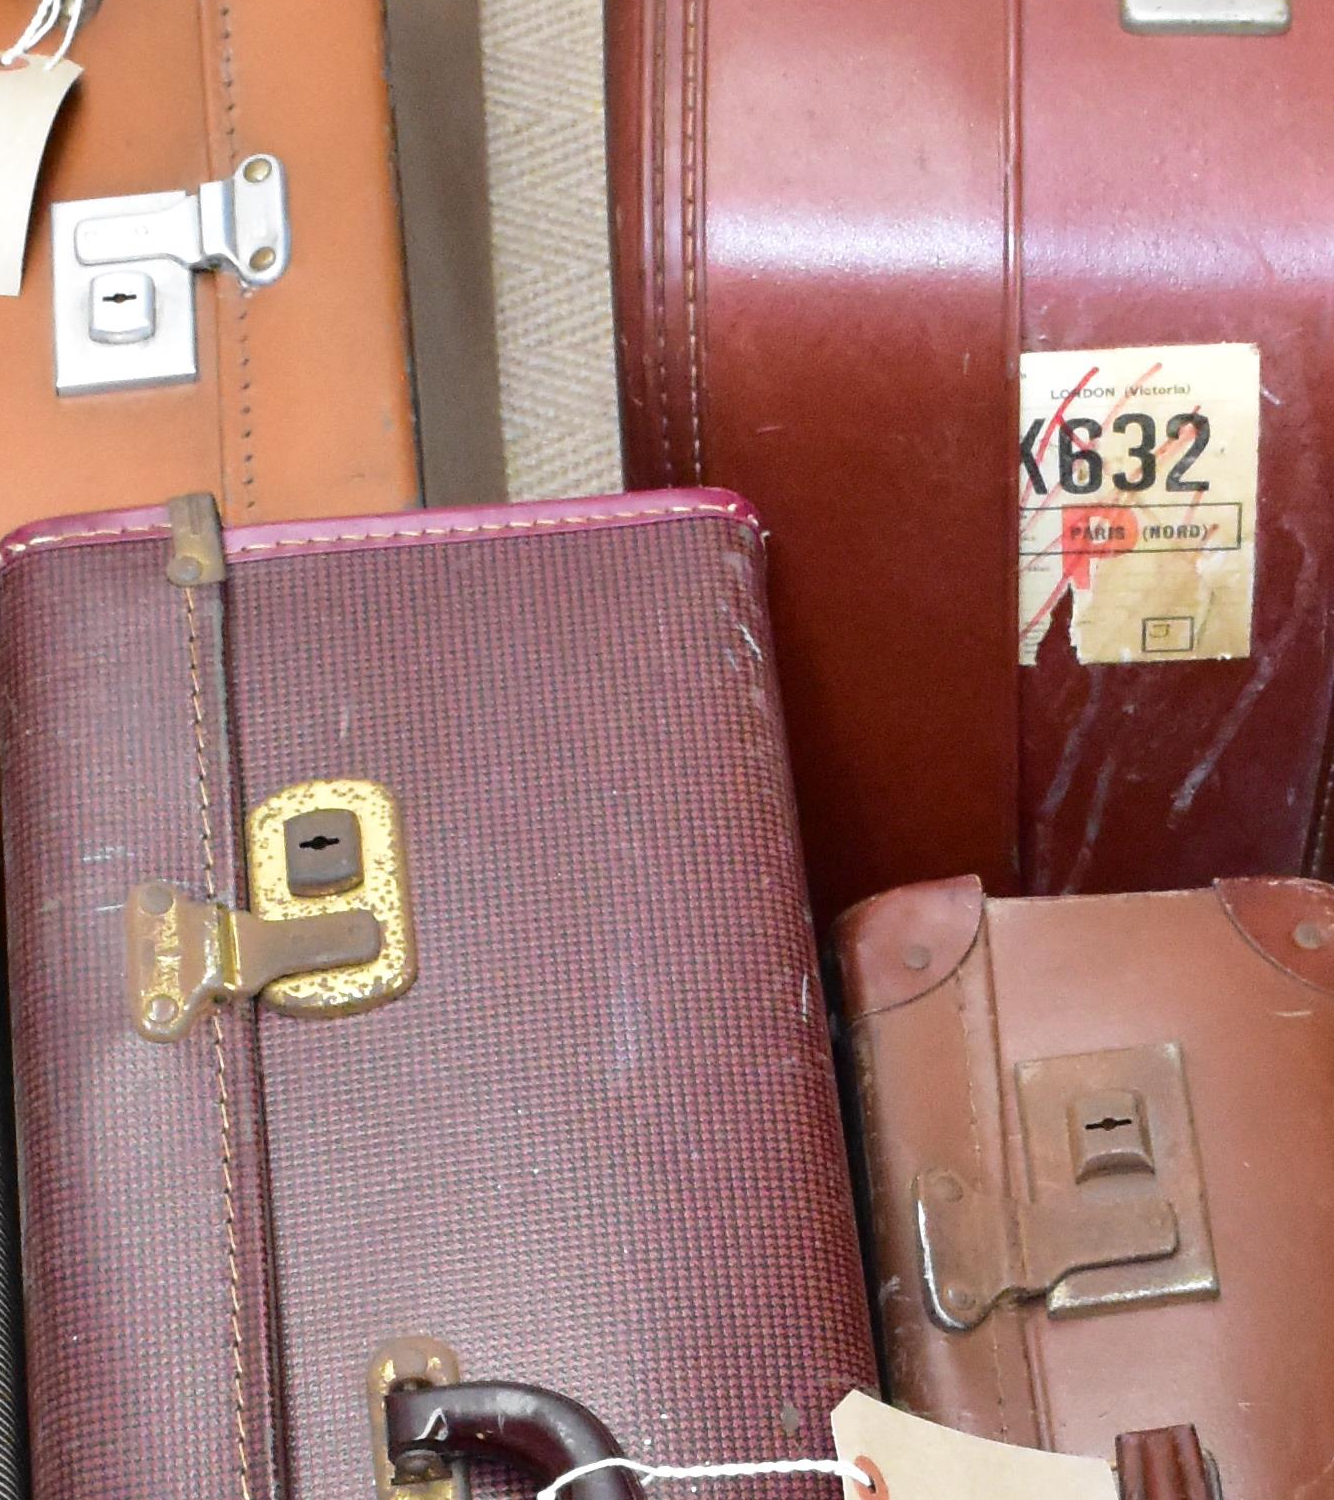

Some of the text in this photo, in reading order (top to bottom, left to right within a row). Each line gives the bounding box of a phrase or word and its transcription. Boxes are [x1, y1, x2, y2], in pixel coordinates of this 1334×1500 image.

[1050, 383, 1192, 400] LONDON (Victoria)
[1070, 523, 1209, 542] PARIS (NORD)
